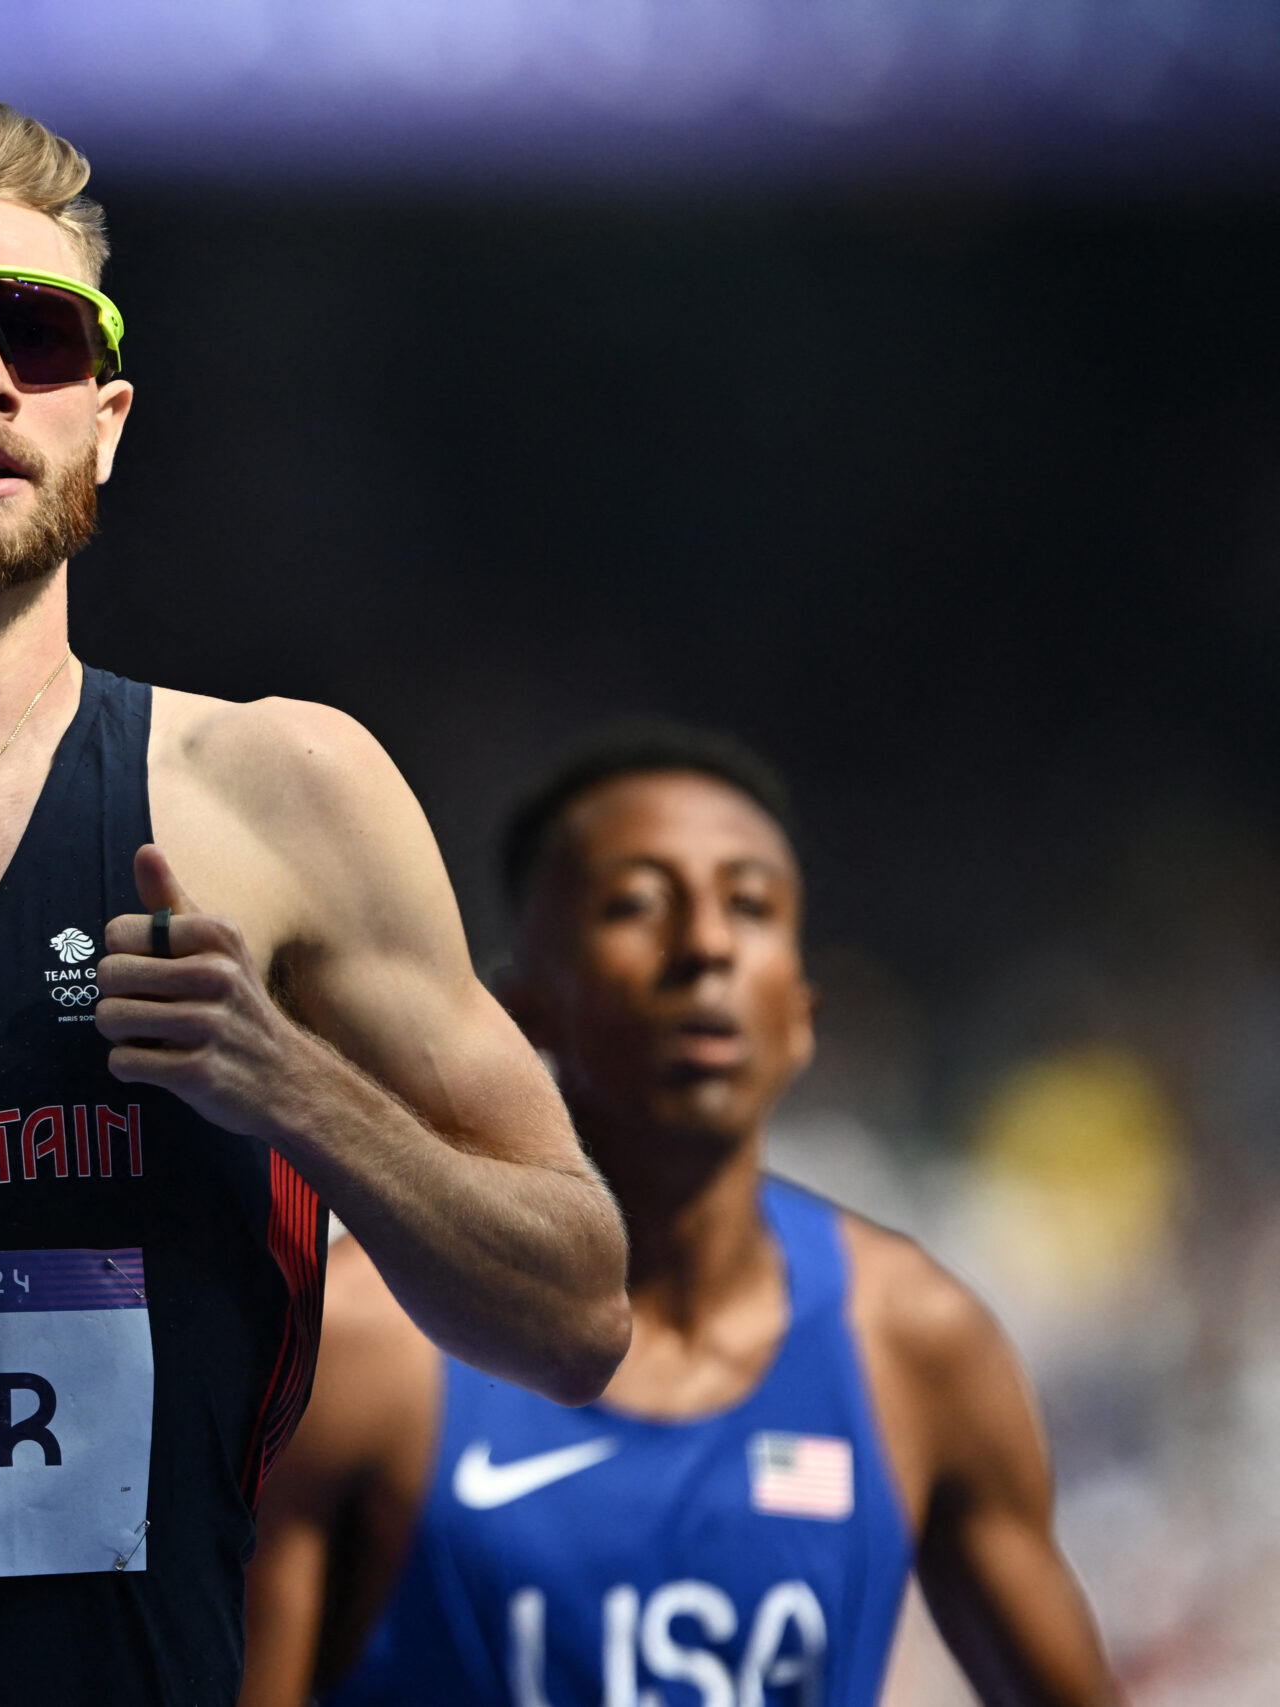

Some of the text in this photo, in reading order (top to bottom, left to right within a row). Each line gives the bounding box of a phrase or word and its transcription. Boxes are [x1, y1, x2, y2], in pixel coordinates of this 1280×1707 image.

[44, 967, 97, 982] TEAM G
[509, 1578, 827, 1707] USA
